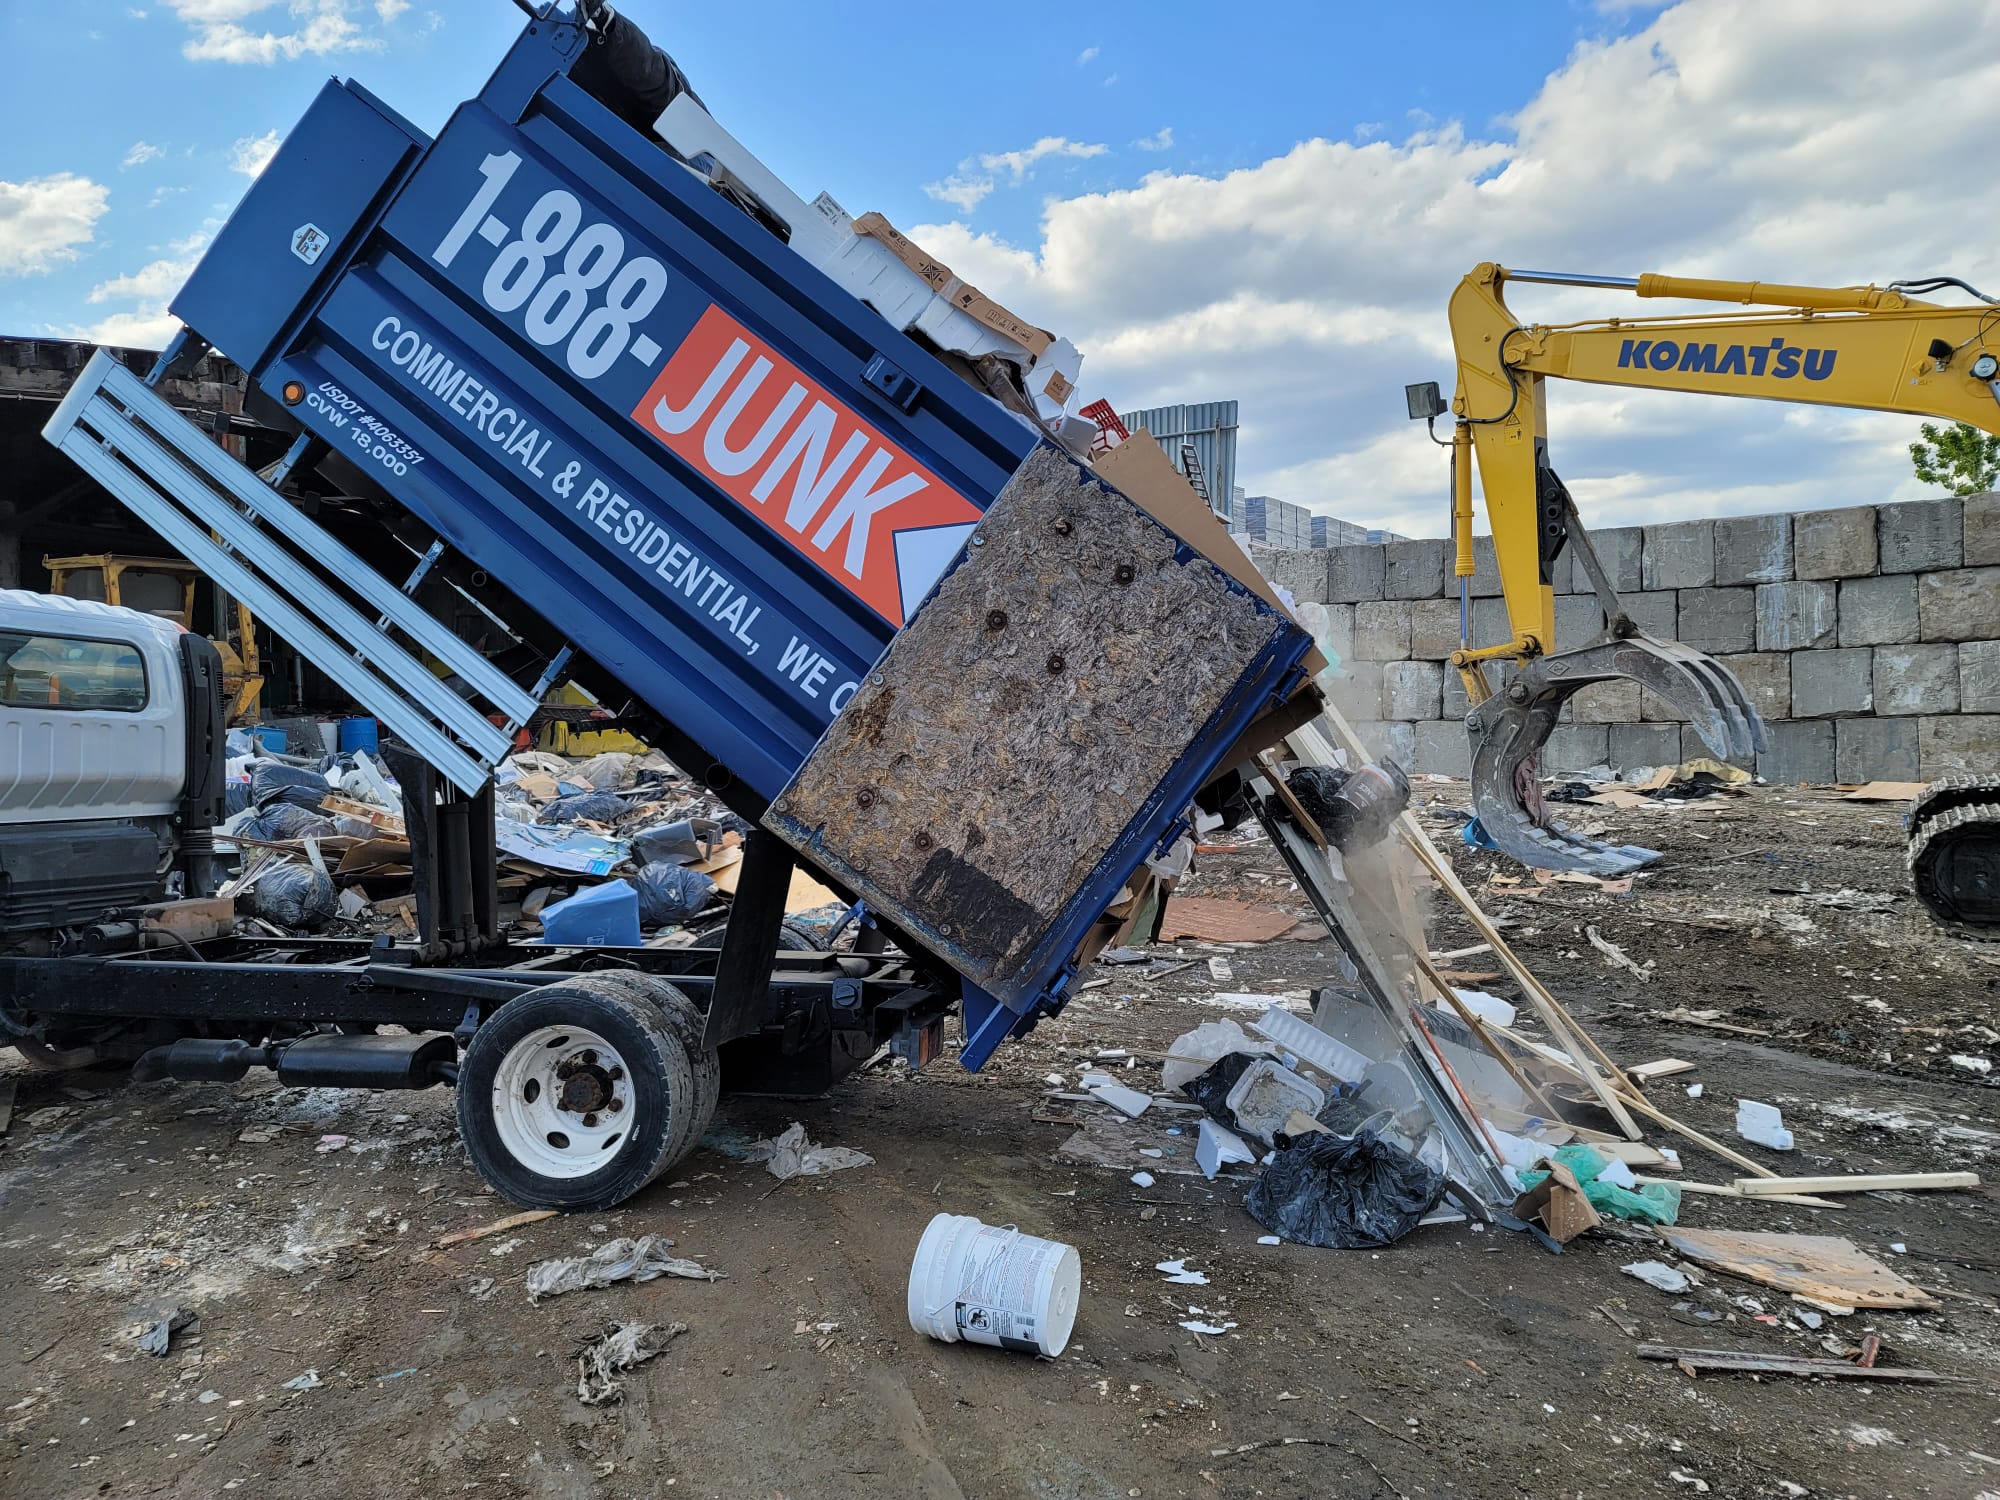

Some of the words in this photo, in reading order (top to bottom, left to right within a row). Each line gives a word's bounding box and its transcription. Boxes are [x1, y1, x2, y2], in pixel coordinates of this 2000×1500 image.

[1617, 337, 1838, 381] KOMATSU
[306, 392, 349, 428] GVW
[351, 427, 408, 476] 18,000
[318, 381, 366, 415] USDOT
[357, 415, 425, 465] #4063351
[653, 336, 931, 581] JUNK
[372, 316, 552, 479] COMMERCIAL
[552, 460, 582, 499] &
[575, 478, 762, 656] RESIDENTIAL,
[776, 635, 837, 699] WE
